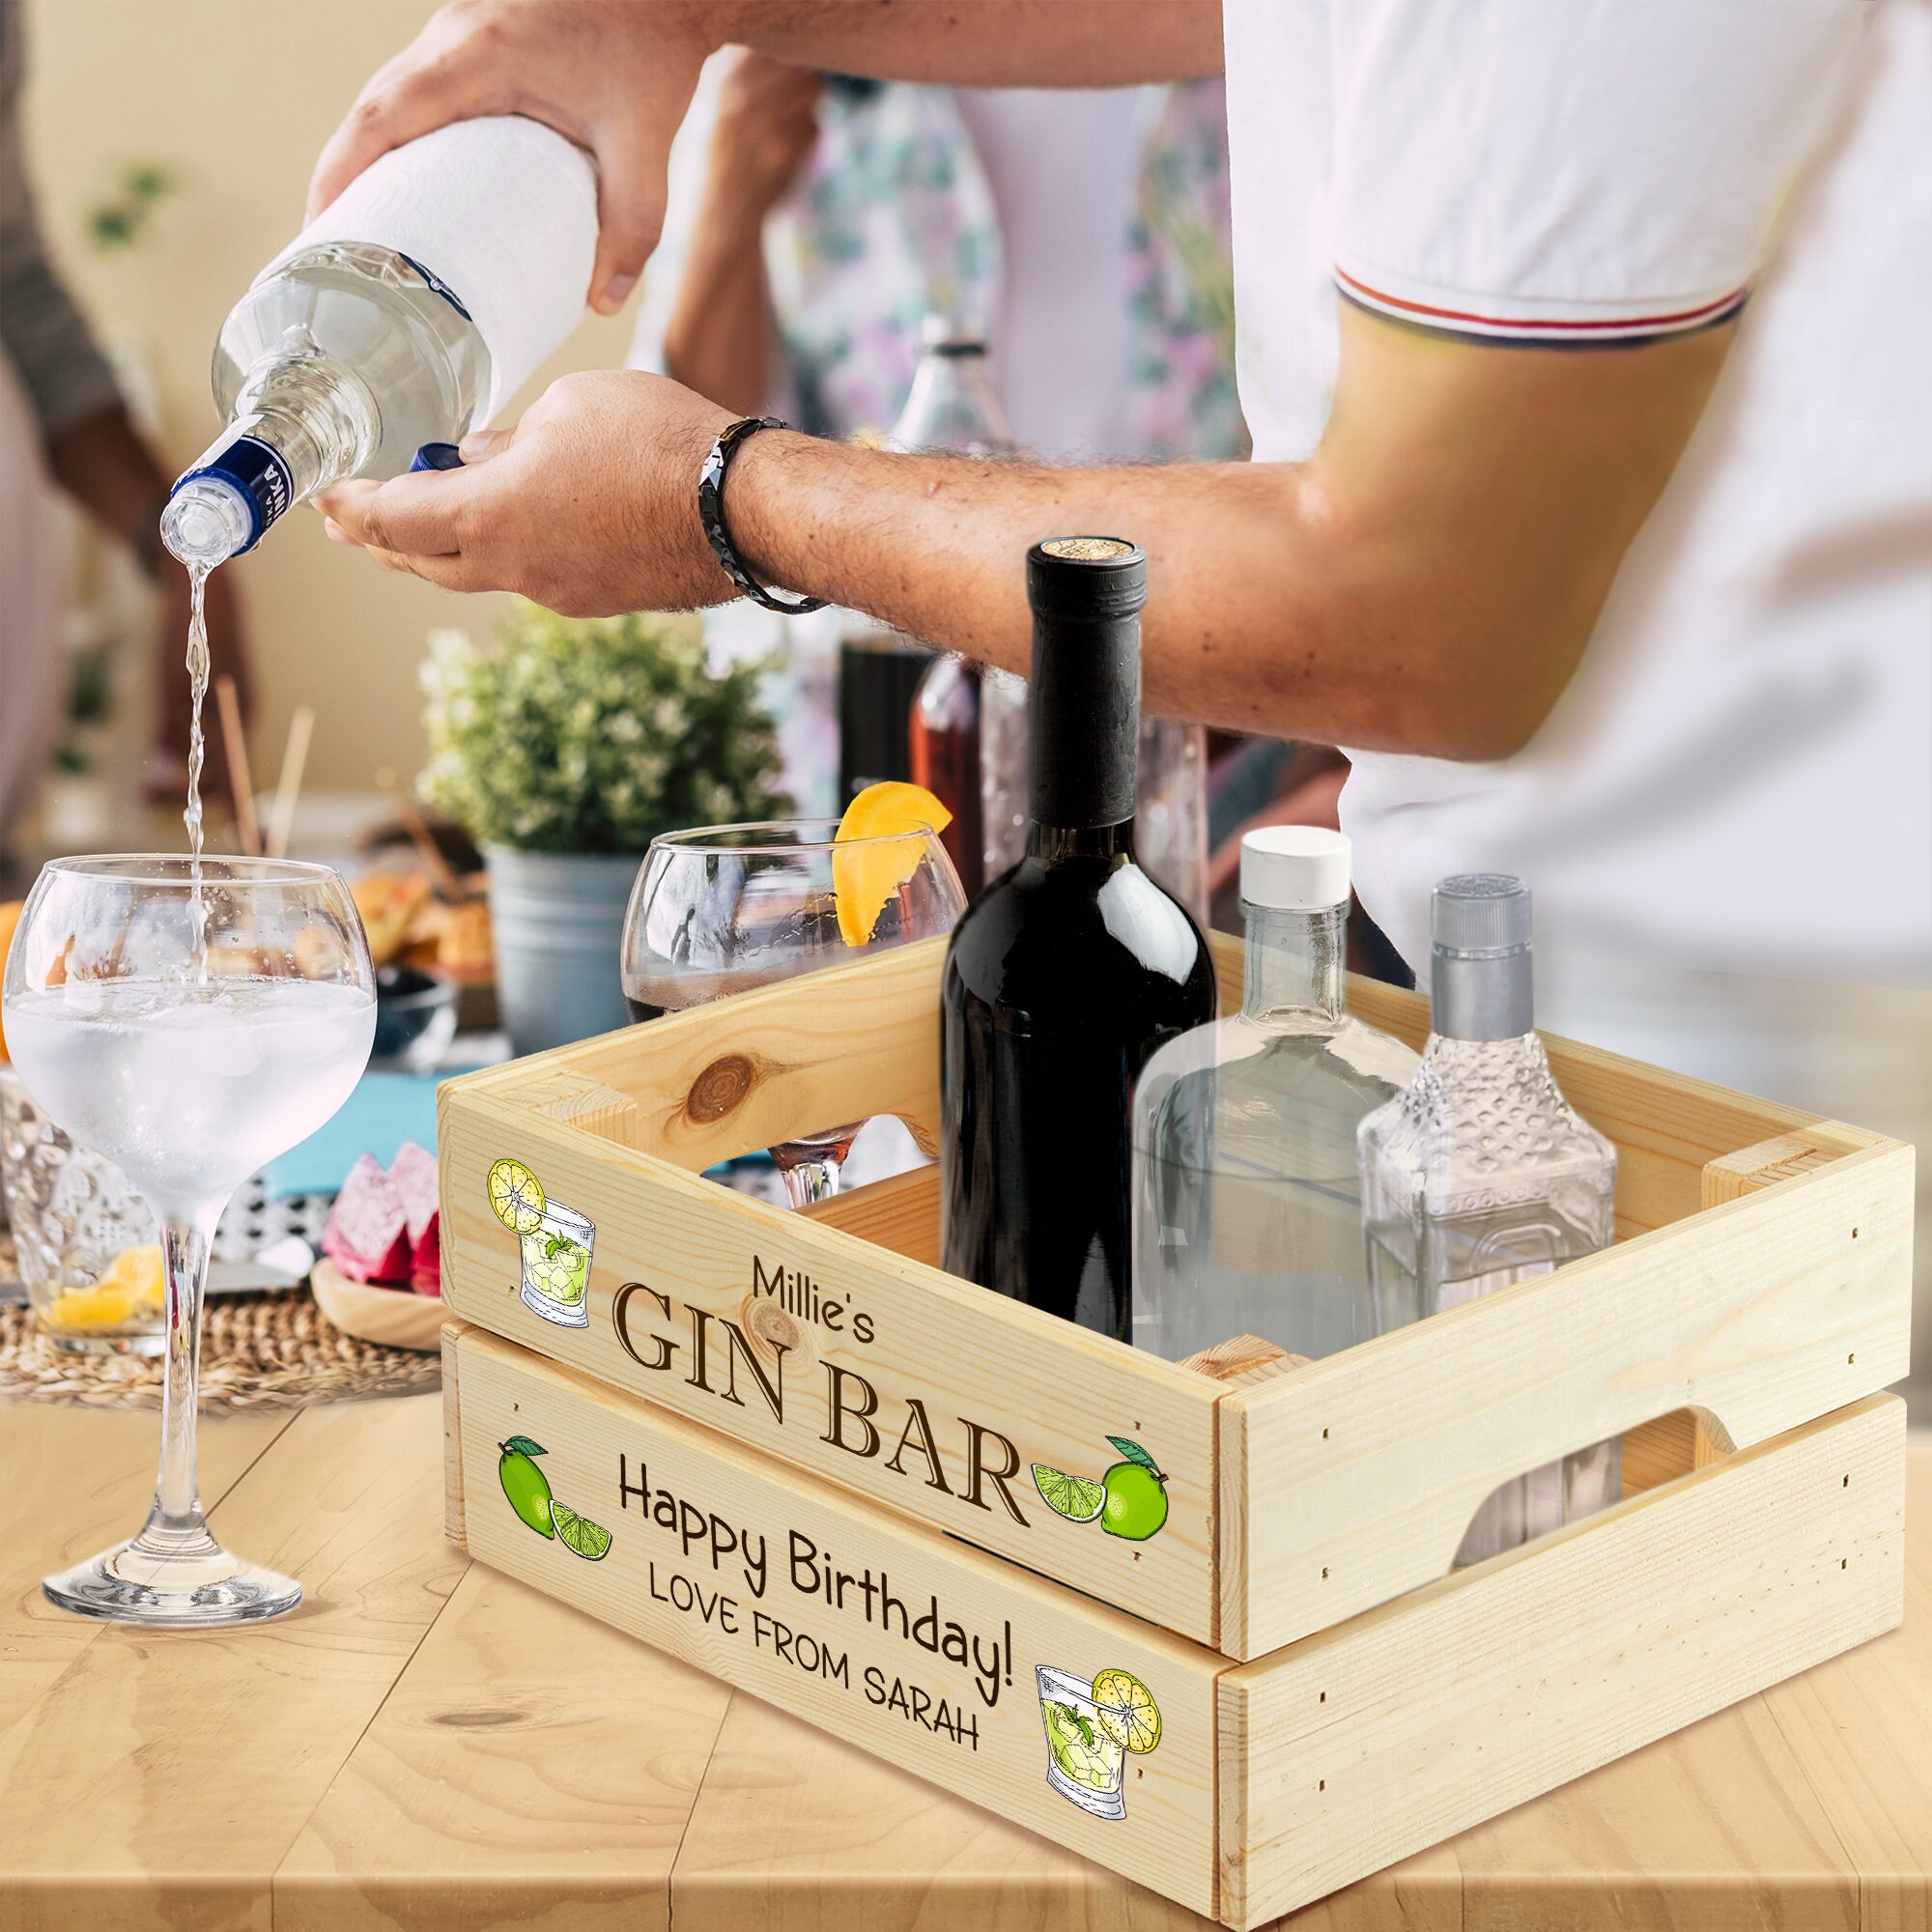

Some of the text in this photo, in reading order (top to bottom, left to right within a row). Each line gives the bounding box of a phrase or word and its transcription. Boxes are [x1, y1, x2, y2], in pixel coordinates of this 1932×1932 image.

[612, 1282, 1031, 1528] GIN BAR
[753, 1255, 875, 1343] Millie's
[619, 1453, 1013, 1707] Happy Birthday!
[649, 1561, 980, 1751] LOVE FROM SARAH
